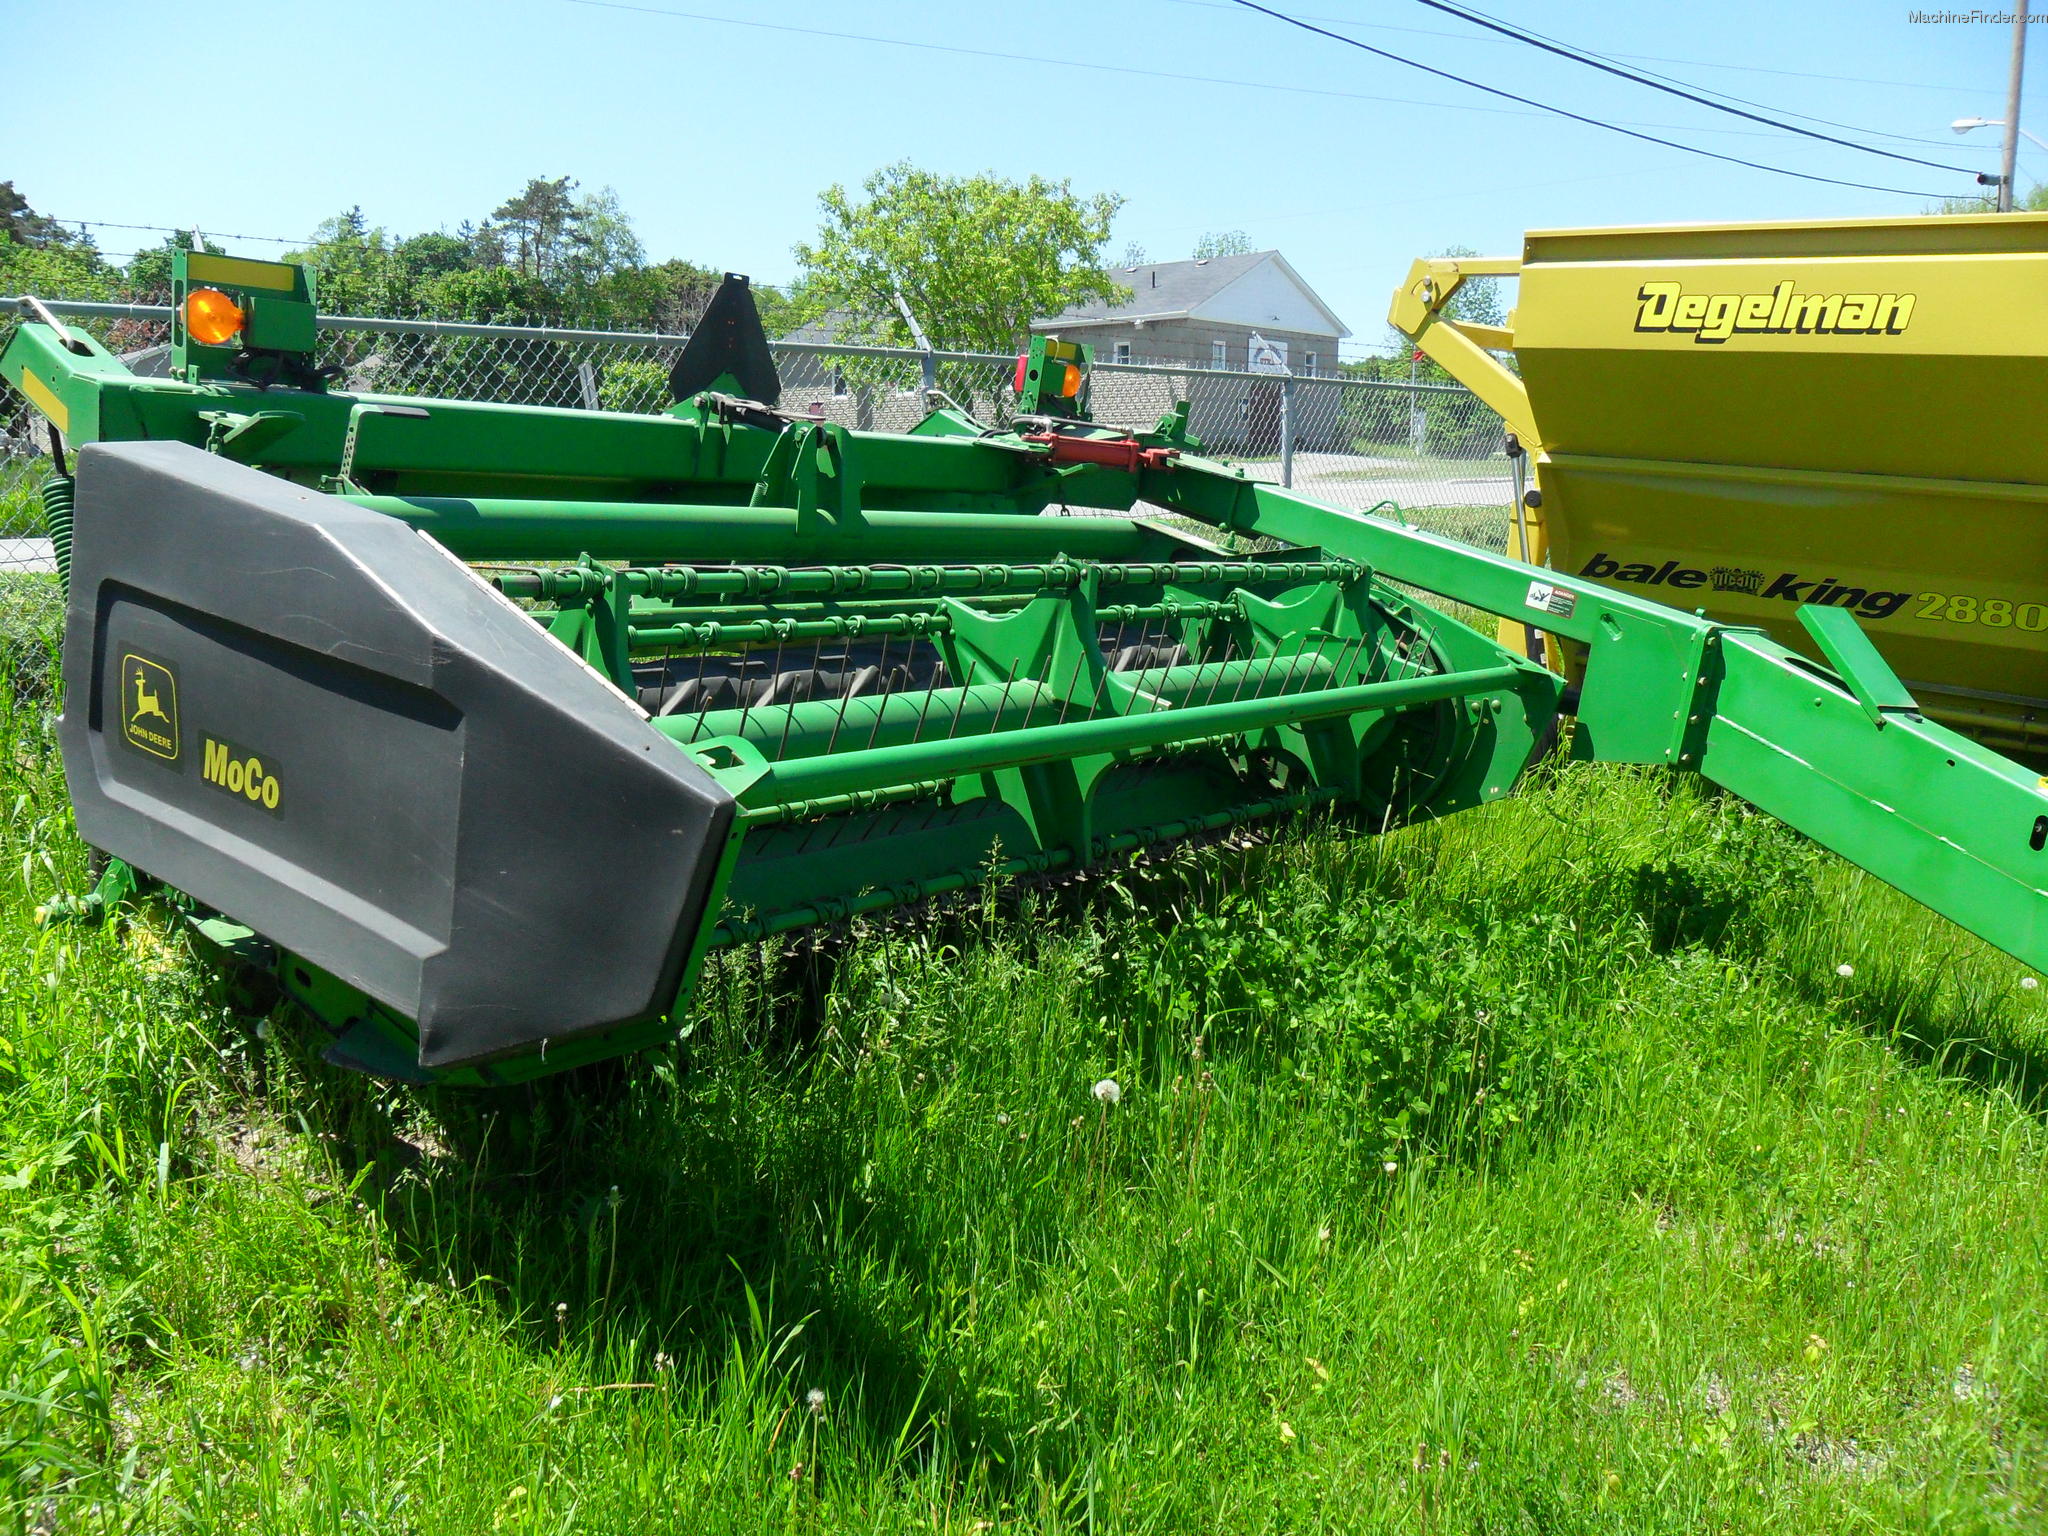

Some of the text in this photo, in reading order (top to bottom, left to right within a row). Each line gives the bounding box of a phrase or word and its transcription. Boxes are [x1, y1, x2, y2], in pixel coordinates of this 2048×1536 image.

[1634, 280, 1917, 344] Degelman
[1579, 553, 2048, 632] bale king 2880
[129, 723, 172, 750] JOHN DEERE
[203, 738, 279, 809] MoCo
